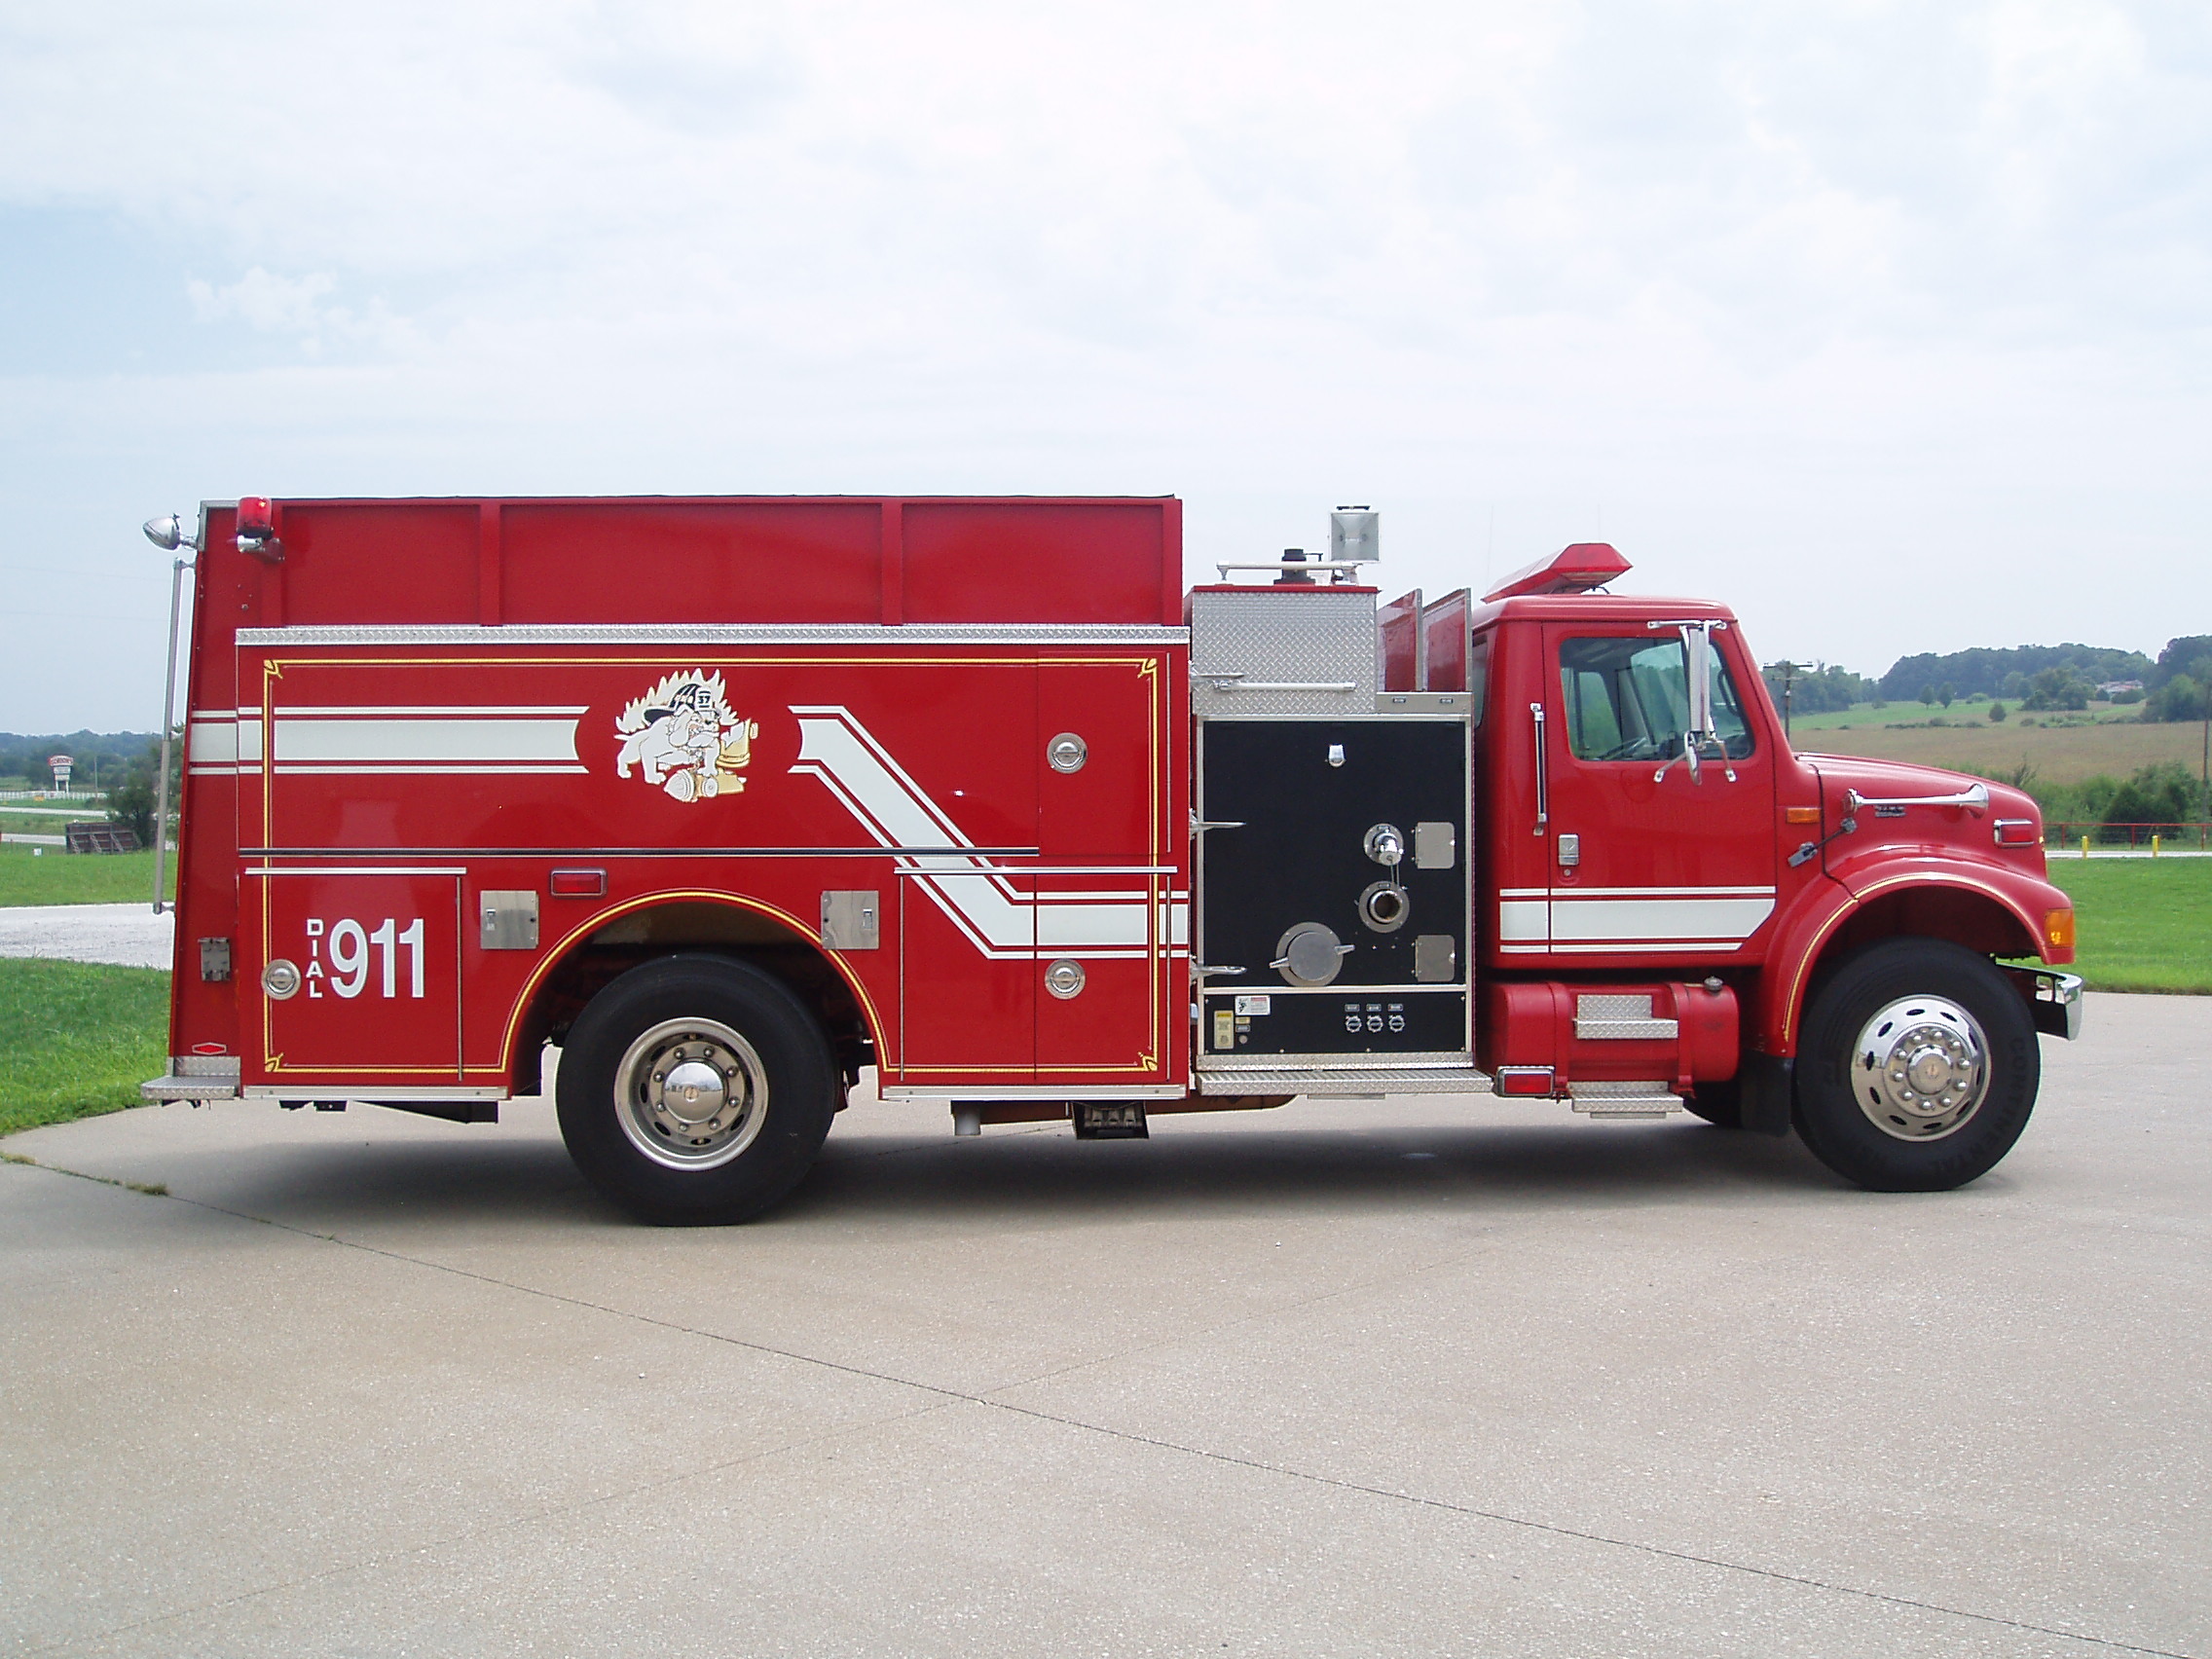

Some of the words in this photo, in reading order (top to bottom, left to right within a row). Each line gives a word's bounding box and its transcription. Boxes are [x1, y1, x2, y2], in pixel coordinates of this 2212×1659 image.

[697, 695, 711, 704] 37
[306, 918, 324, 998] DIAL
[329, 918, 424, 998] 911
[1931, 1037, 2027, 1174] CONTINENTAL
